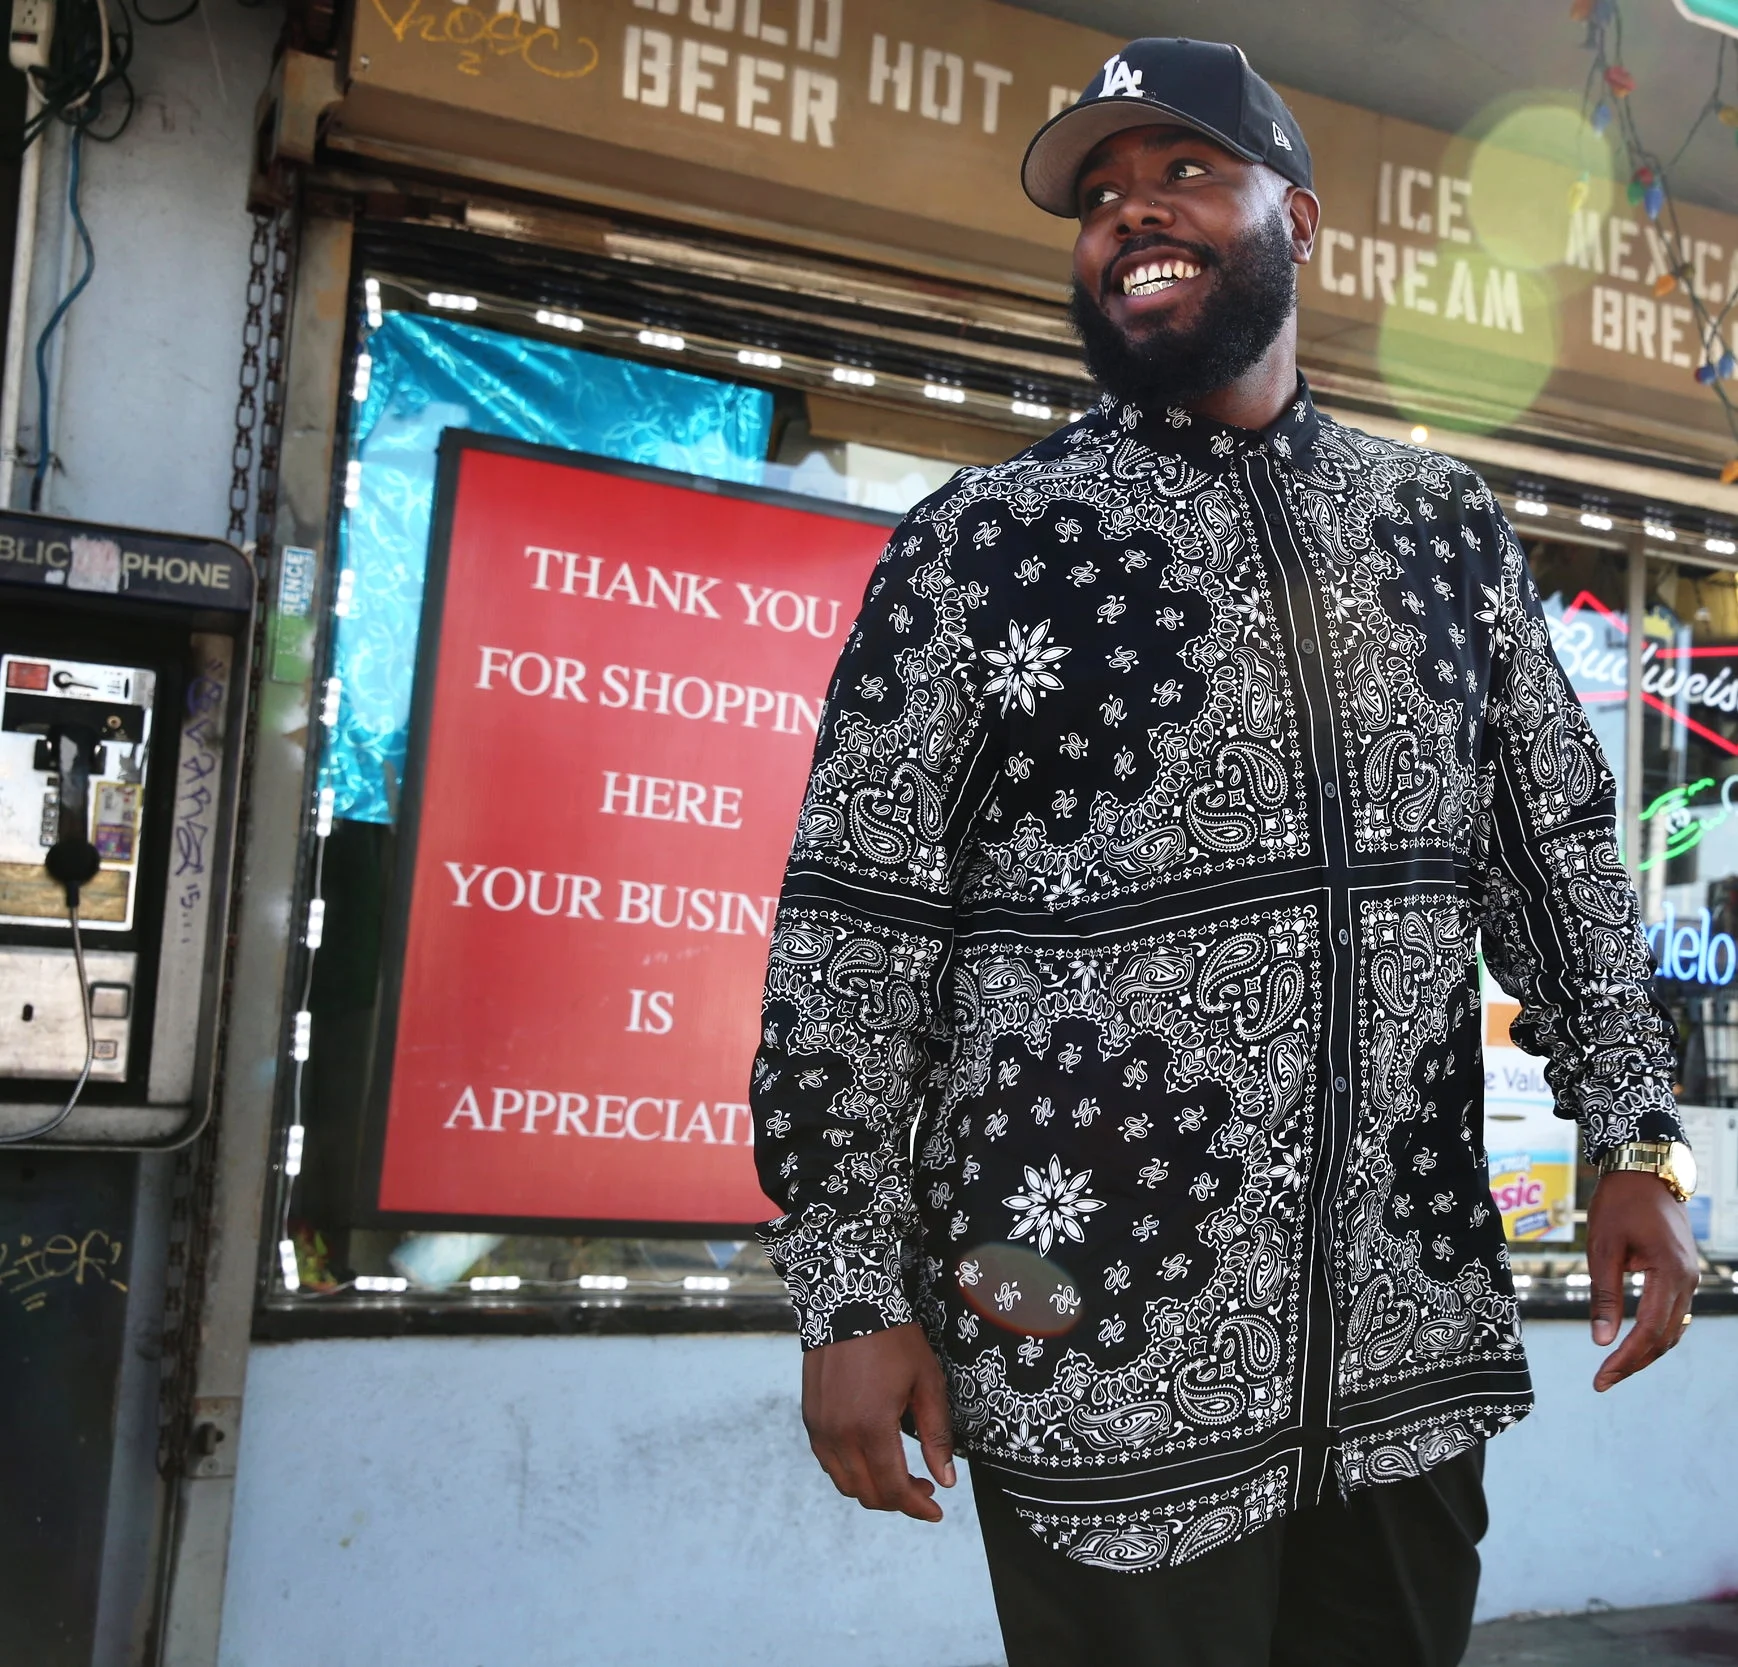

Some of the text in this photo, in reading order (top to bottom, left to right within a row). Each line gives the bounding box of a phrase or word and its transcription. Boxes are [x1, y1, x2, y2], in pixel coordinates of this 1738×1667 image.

[633, 0, 843, 59] LD
[623, 24, 839, 148] BEER
[868, 32, 1012, 135] HOT
[1098, 54, 1145, 99] LA
[1377, 161, 1473, 245] ICE
[1319, 226, 1525, 335] CREAM
[1564, 208, 1738, 308] MEXIC
[0, 534, 232, 589] BLIC PHONE
[523, 545, 843, 639] THANK YOU
[474, 645, 826, 737] FOR SHOPPIN
[1545, 613, 1738, 713] Budweis
[598, 770, 744, 830] HERE
[444, 861, 780, 938] YOUR BUSIN
[1643, 901, 1737, 985] delo
[625, 989, 674, 1035] IS
[444, 1086, 755, 1147] APPRECIAT
[1502, 1067, 1549, 1093] Valu
[1491, 1176, 1541, 1211] sic
